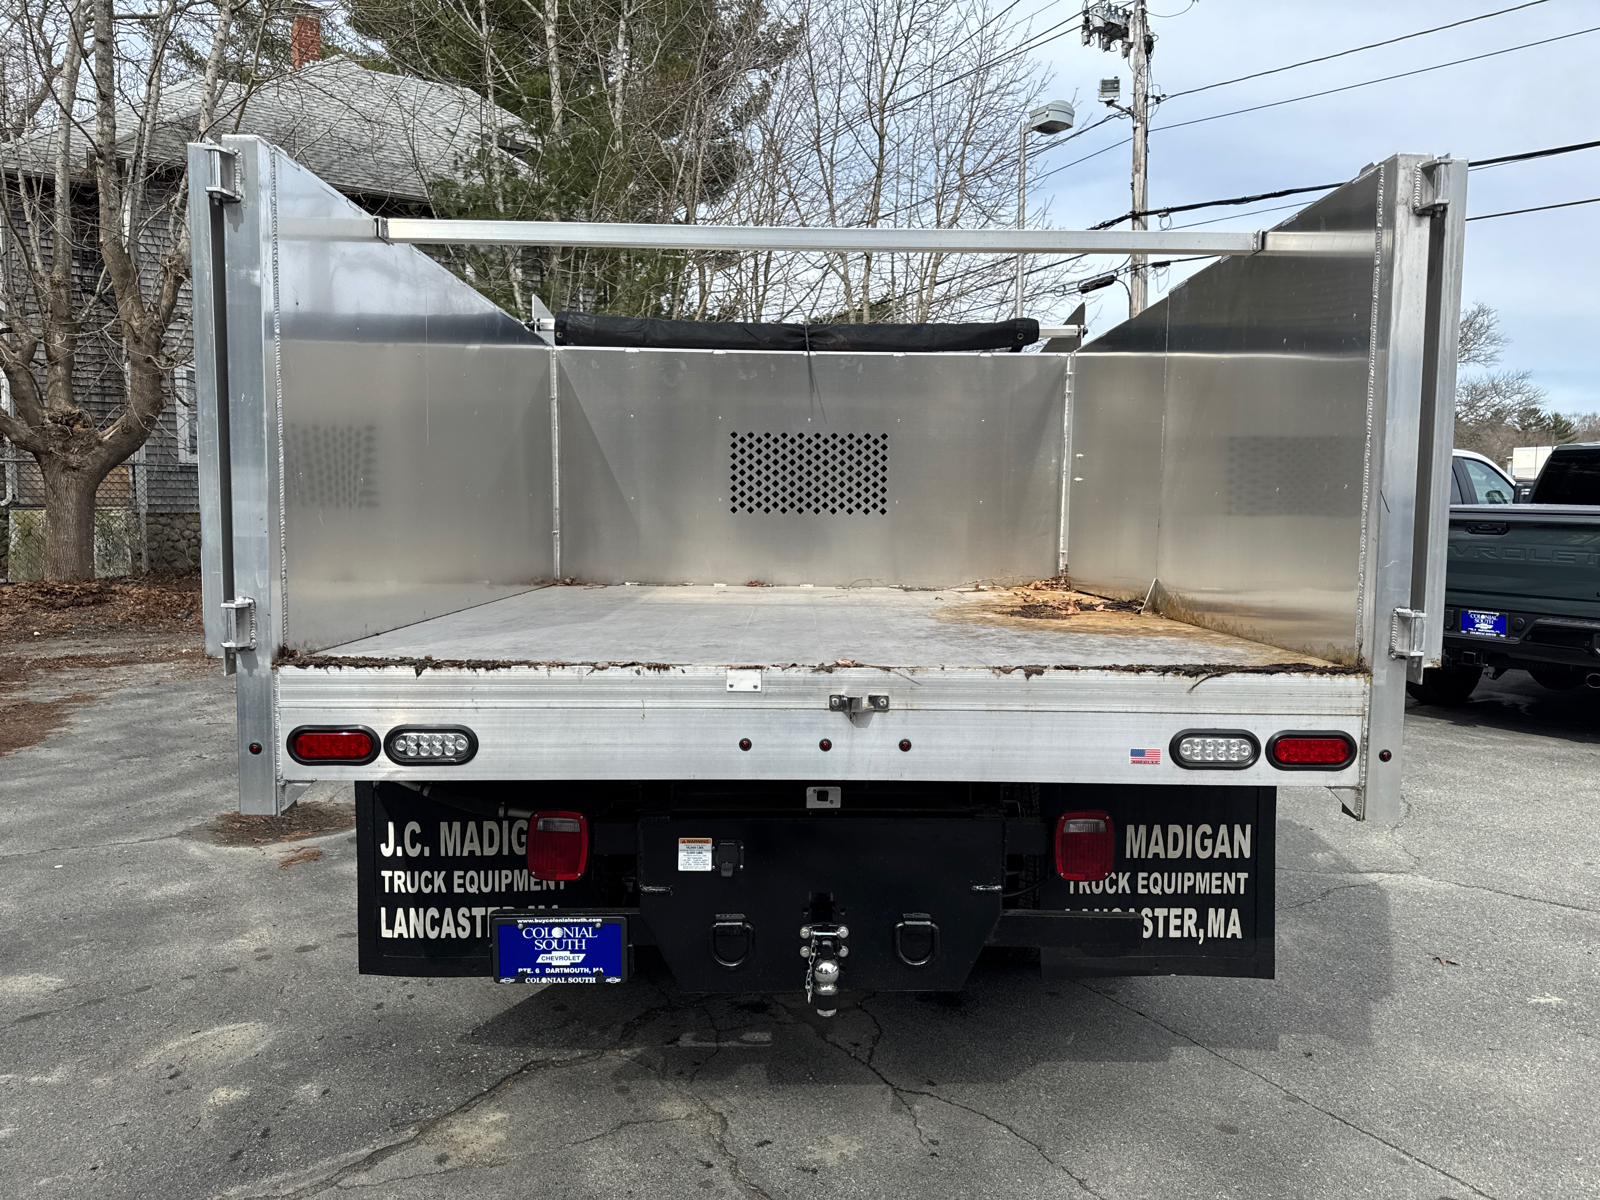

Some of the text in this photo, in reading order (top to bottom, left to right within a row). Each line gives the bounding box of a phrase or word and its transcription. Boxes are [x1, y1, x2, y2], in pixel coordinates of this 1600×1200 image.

[1448, 545, 1600, 564] VROLET
[380, 820, 528, 857] J.C. MADIG
[1125, 824, 1252, 859] MADIGAN
[380, 871, 447, 893] TRUCK
[1137, 872, 1249, 895] EQUIPMENT
[380, 906, 515, 939] LANCAST
[522, 927, 598, 939] COLONIAL
[534, 939, 587, 951] SOUTH
